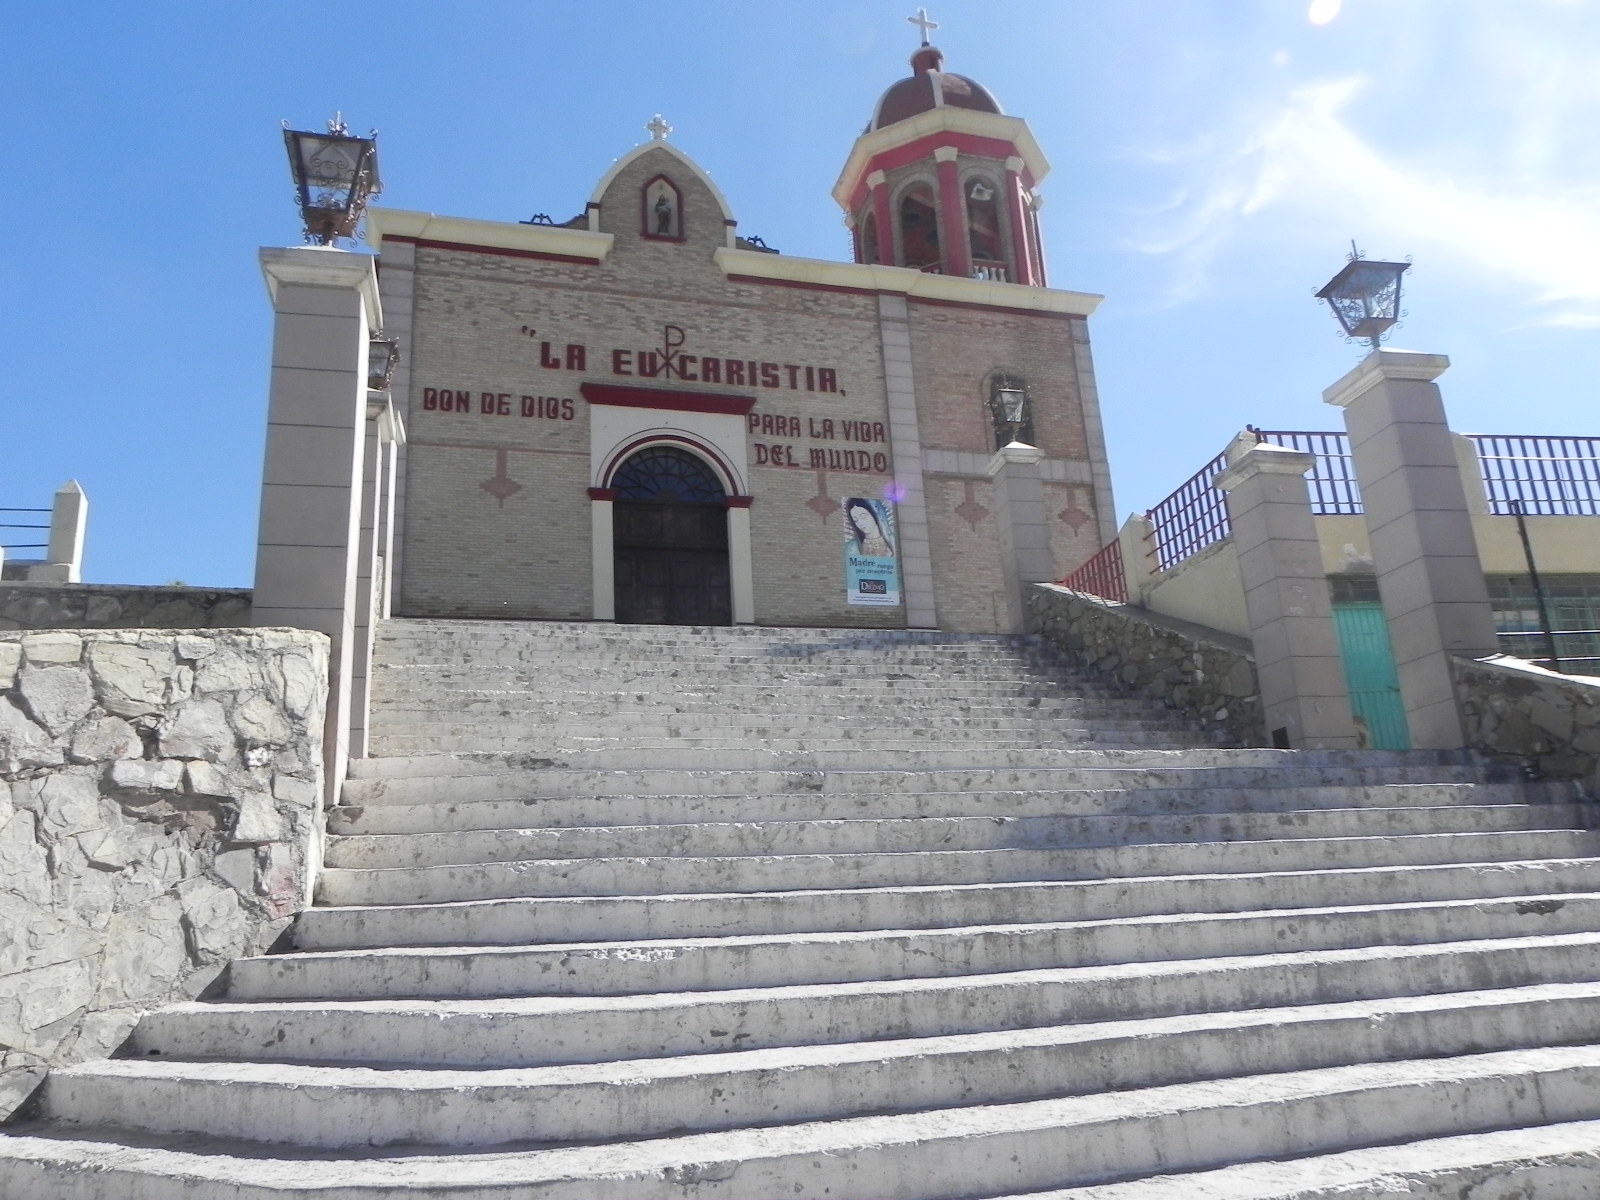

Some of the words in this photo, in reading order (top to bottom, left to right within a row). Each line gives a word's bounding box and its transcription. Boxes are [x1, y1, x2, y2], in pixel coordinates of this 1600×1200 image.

[423, 387, 470, 413] DON
[480, 392, 512, 416] DE
[521, 395, 575, 421] DIOS
[748, 412, 801, 438] PARA
[809, 417, 834, 440] LA
[841, 420, 885, 443] VIDA
[754, 443, 800, 468] DEL
[808, 447, 888, 473] MUNDO
[849, 557, 876, 567] Madre
